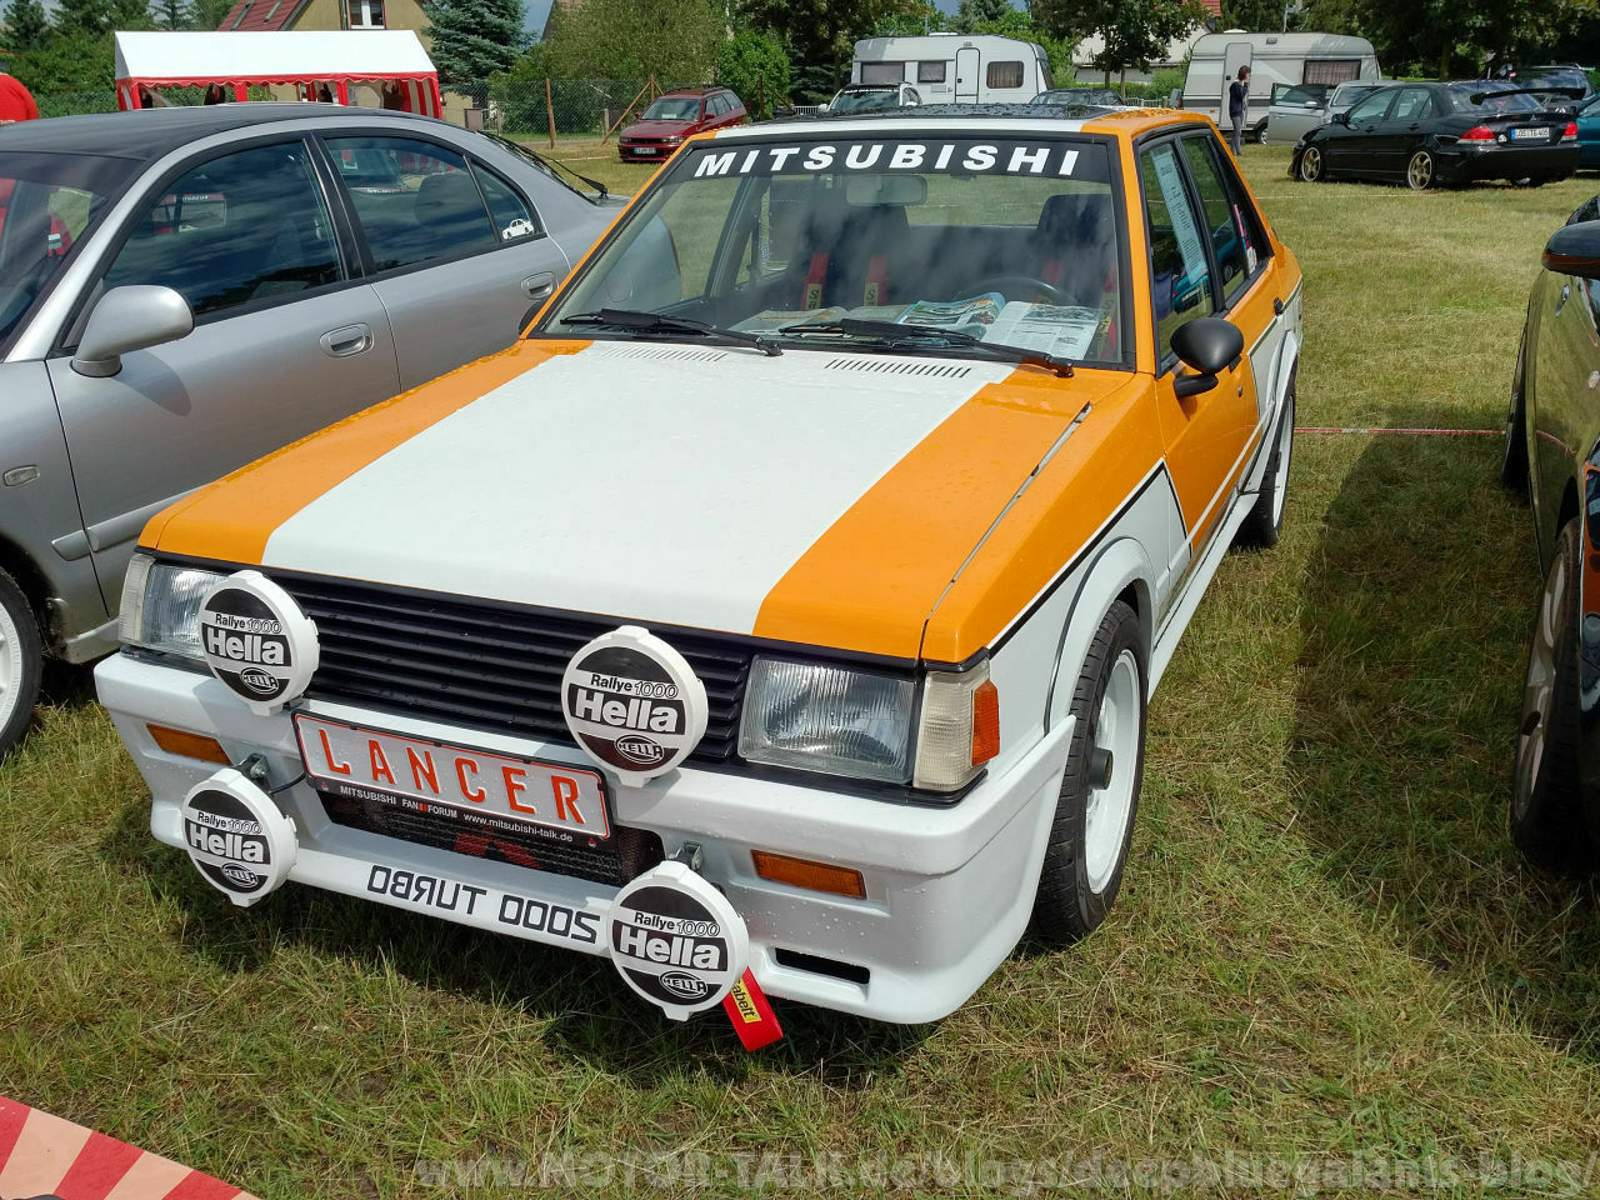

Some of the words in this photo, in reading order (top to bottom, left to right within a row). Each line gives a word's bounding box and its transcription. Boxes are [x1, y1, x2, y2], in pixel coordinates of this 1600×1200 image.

[694, 144, 1079, 177] MITSUBISHI
[215, 613, 246, 630] Rallye
[247, 619, 282, 634] 1000
[207, 626, 285, 665] Hella
[241, 673, 279, 688] HELLA
[591, 673, 633, 692] Rallye
[634, 681, 679, 700] 1000
[575, 688, 678, 733] Hella
[618, 742, 664, 758] HELLA
[318, 728, 586, 825] LANCER
[198, 811, 227, 828] Rallye
[228, 819, 263, 835] 1000
[340, 785, 398, 805] MITSUBISHI
[463, 812, 574, 842] www.mitsubishi-talk.de
[189, 822, 265, 863] Hella
[223, 869, 257, 882] HELLA
[634, 912, 675, 931] Rallye
[676, 919, 721, 937] 1000
[619, 924, 721, 970] Hella
[664, 976, 707, 993] HELLA
